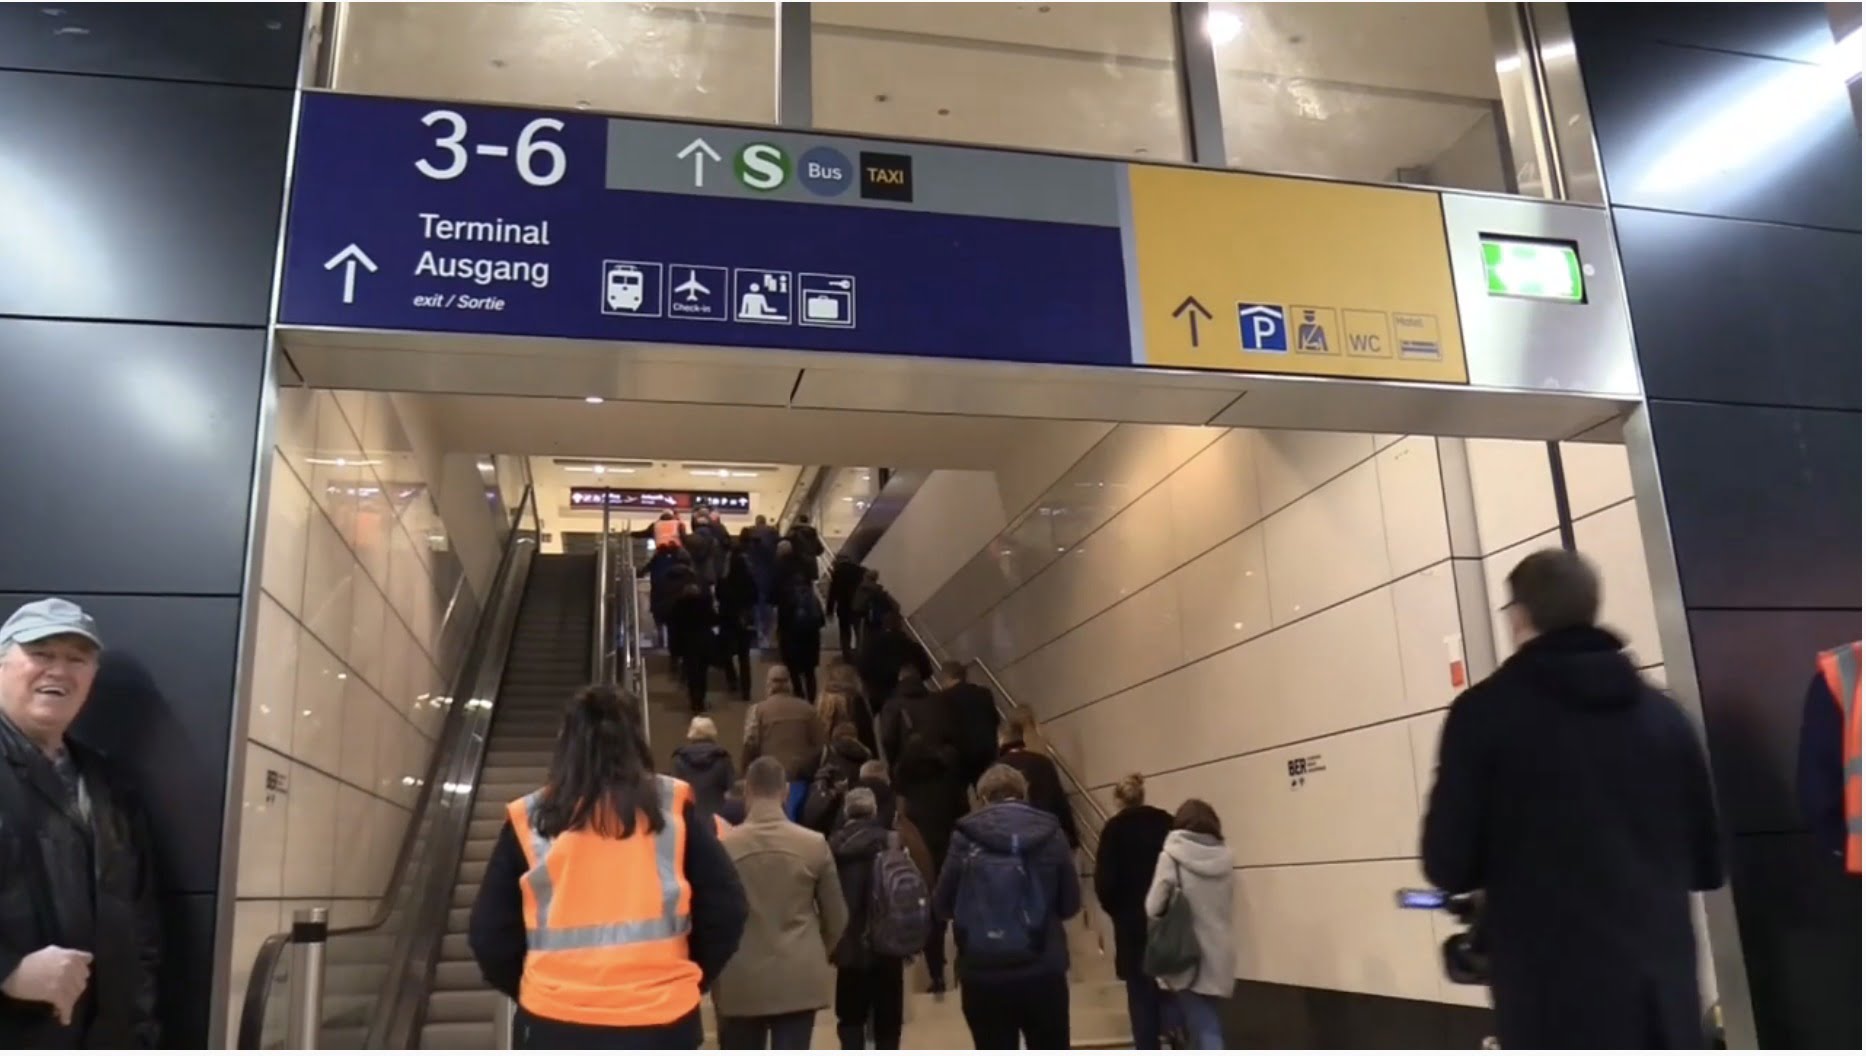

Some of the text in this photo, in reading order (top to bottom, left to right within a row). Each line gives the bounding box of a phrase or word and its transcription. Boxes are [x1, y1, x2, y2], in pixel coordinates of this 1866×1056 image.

[414, 109, 567, 187] 3-6
[743, 144, 904, 189] S Bus TAXI
[419, 213, 550, 245] Terminal
[414, 250, 549, 288] Ausgang
[413, 293, 444, 308] exit
[457, 294, 505, 311] Sortie
[673, 302, 712, 314] Check-in
[1253, 316, 1276, 349] P
[1350, 334, 1381, 353] WC
